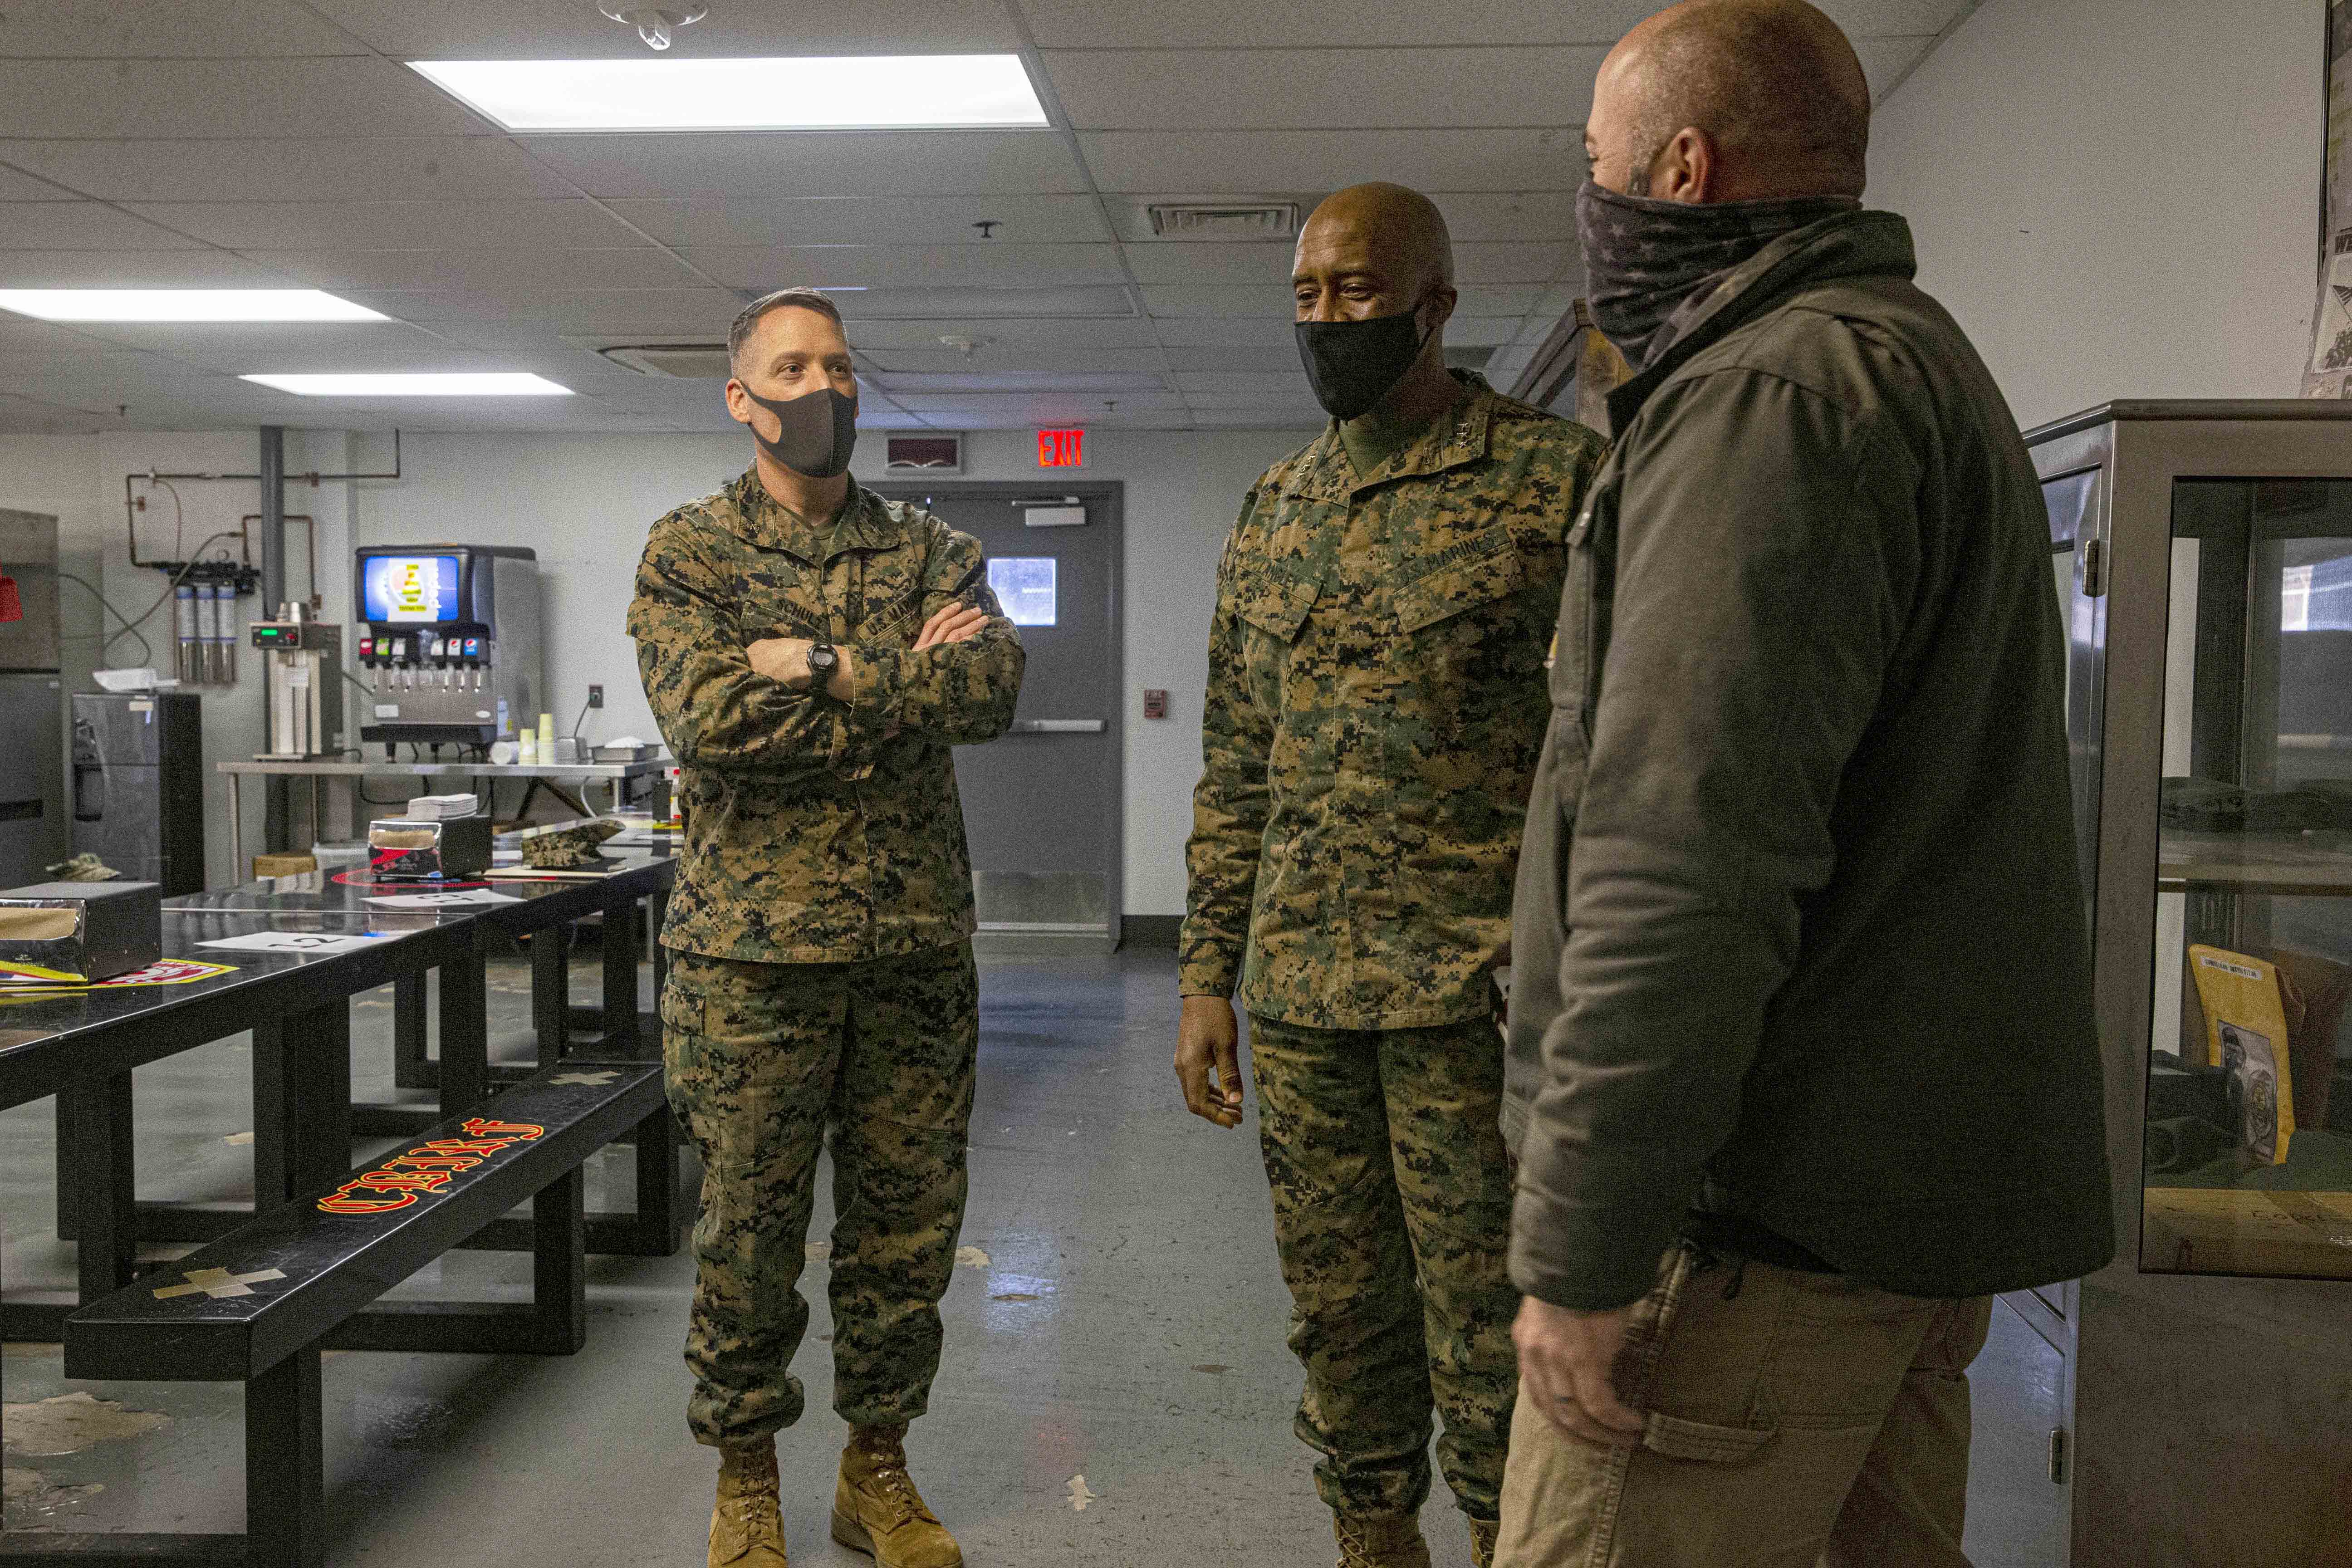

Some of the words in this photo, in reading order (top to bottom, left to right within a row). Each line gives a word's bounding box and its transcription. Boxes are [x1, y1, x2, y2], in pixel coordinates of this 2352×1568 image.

[1038, 430, 1085, 466] EXIT
[1426, 533, 1495, 571] MARINES
[866, 617, 890, 635] U.S.
[267, 937, 345, 948] 12
